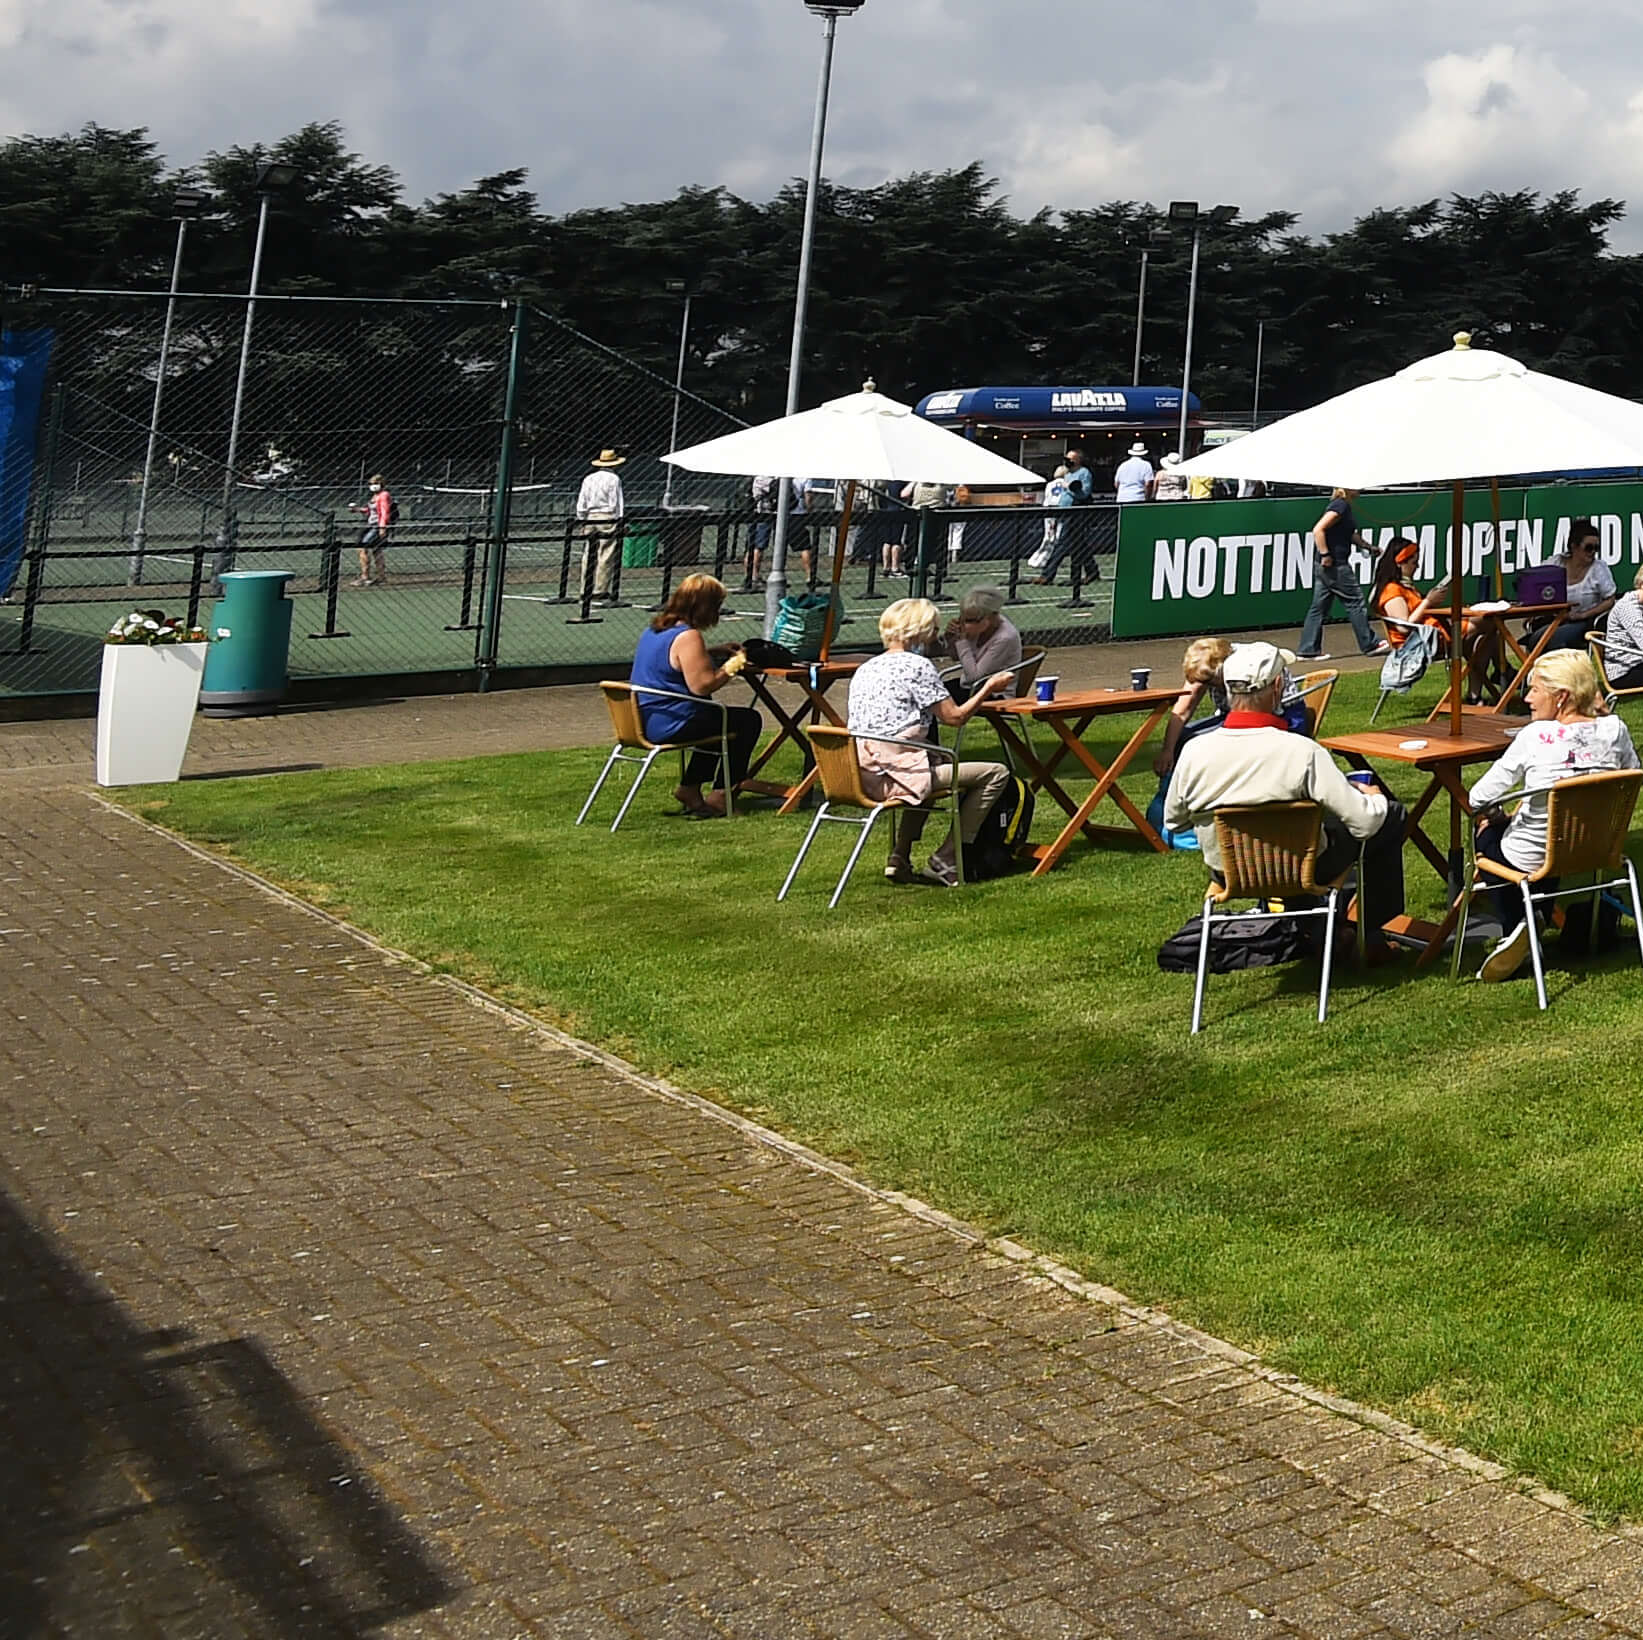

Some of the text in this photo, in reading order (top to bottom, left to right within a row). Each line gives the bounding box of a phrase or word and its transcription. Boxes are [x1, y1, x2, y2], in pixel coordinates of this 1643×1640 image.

[1052, 389, 1127, 407] LAVAZZA
[1151, 525, 1437, 601] NOTTINHAM
[1446, 518, 1544, 577] OPEN
[1552, 514, 1622, 566] AD
